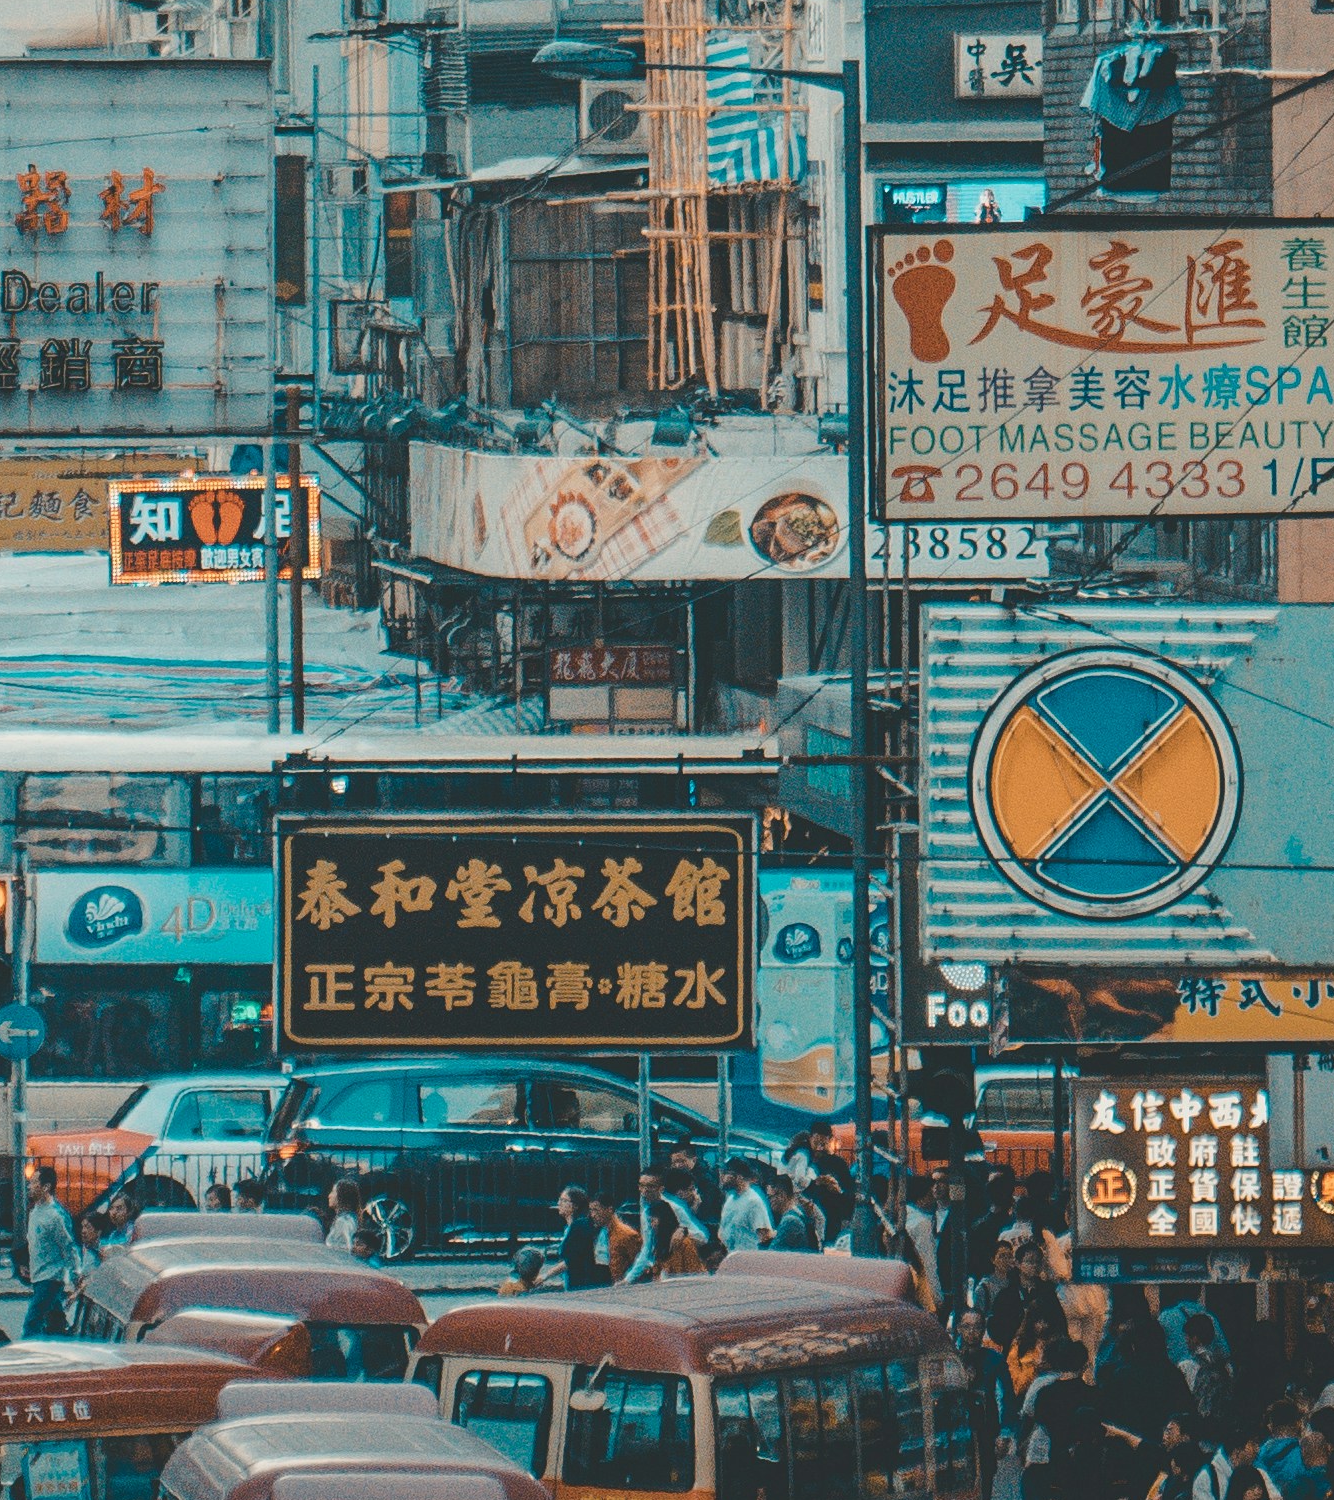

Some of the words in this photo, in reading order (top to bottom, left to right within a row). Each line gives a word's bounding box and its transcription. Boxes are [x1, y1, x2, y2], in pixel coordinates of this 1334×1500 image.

[991, 43, 1043, 87] 吳
[1, 268, 161, 314] Dealer
[1279, 237, 1330, 350] 養生館
[889, 425, 987, 457] FOOT
[998, 422, 1178, 453] MASSAGE
[1190, 418, 1334, 450] BEAUTY
[954, 461, 1091, 501] 2649
[1109, 459, 1247, 499] 4333
[129, 493, 185, 546] 知
[161, 896, 216, 943] 4D
[615, 958, 729, 1014] 糖水
[57, 1143, 85, 1156] TAXI
[1091, 1168, 1130, 1204] 正
[1145, 1168, 1305, 1202] 正貨保證
[1145, 1202, 1304, 1237] 全國快遞
